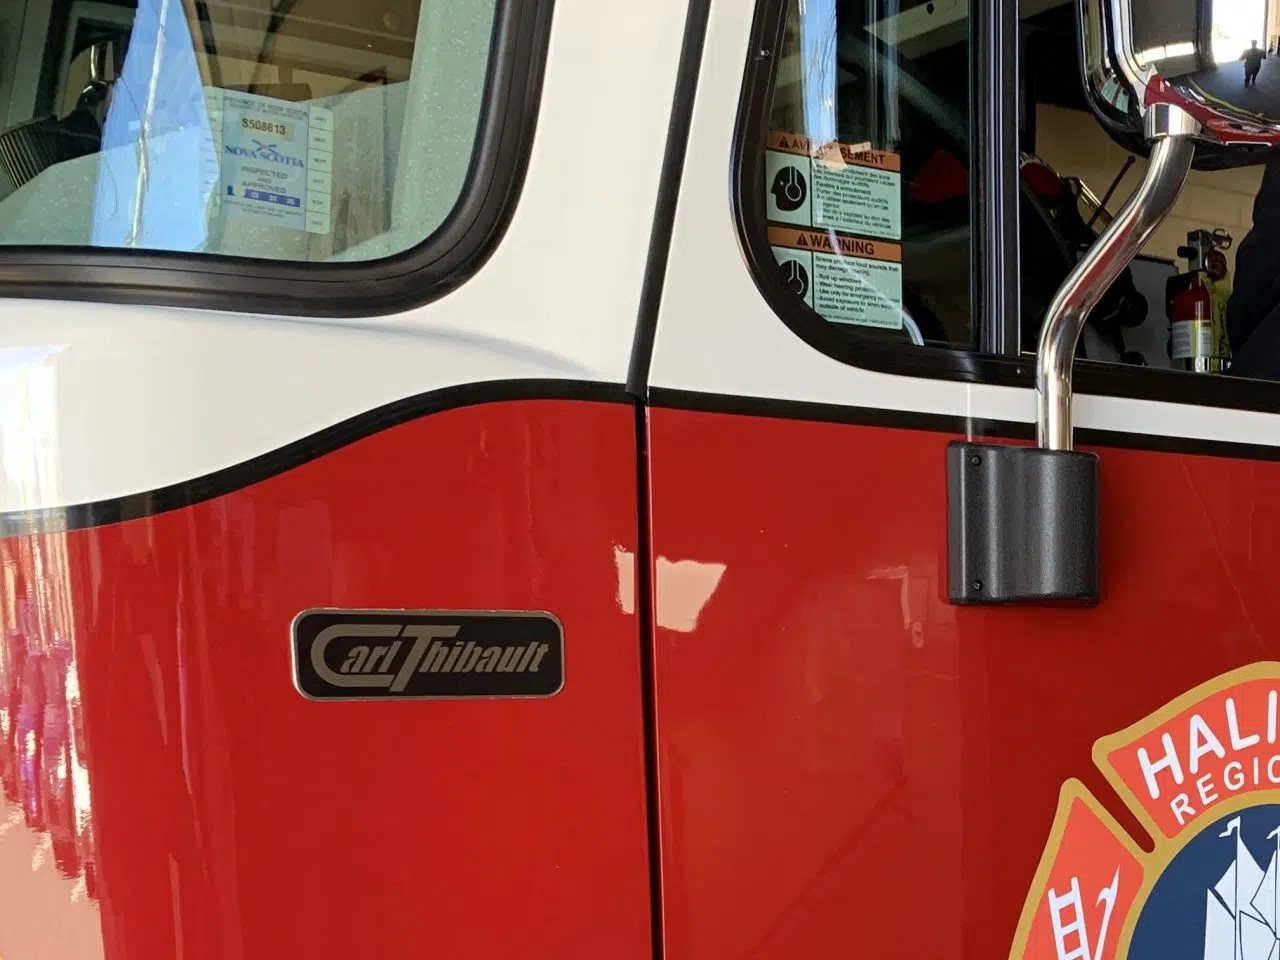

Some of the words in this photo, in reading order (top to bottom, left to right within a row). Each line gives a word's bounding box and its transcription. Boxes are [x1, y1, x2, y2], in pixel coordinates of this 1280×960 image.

[242, 118, 286, 135] S508613
[224, 145, 257, 159] NOVA
[260, 151, 305, 168] SCOTIA
[810, 234, 874, 255] WANING
[310, 624, 402, 688] Carl
[389, 625, 550, 692] Thibault
